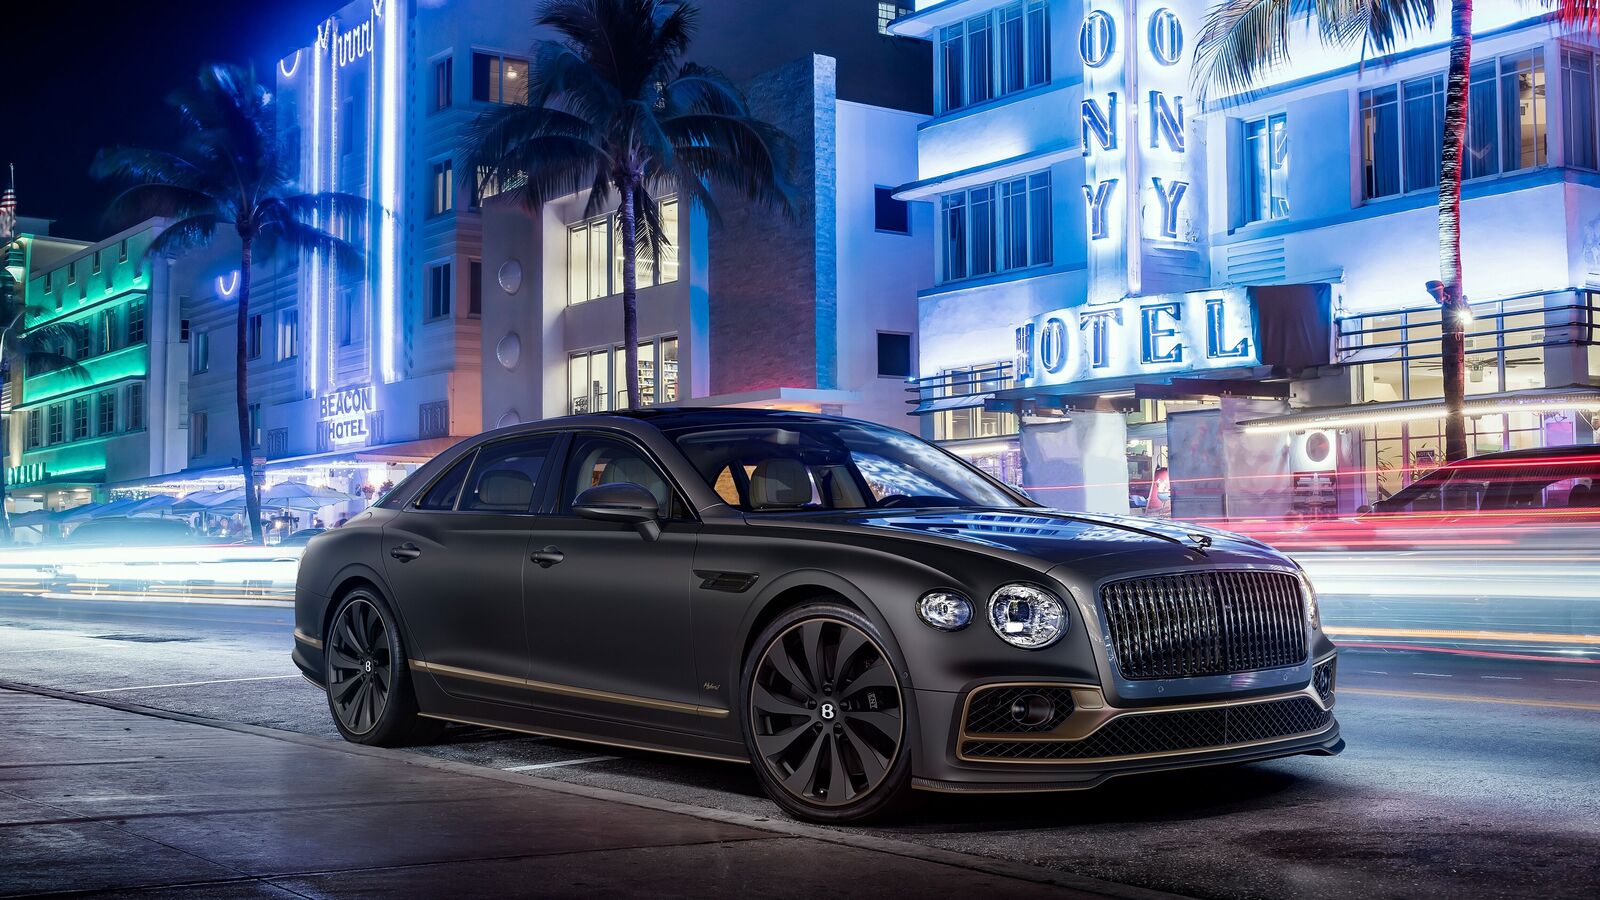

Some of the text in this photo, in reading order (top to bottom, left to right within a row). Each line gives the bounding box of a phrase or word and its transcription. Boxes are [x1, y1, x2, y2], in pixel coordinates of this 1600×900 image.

[1015, 299, 1250, 381] HOTEL
[320, 388, 373, 418] BEACON
[328, 419, 367, 439] HOTEL
[8, 462, 44, 485] AVALON
[821, 703, 834, 718] B
